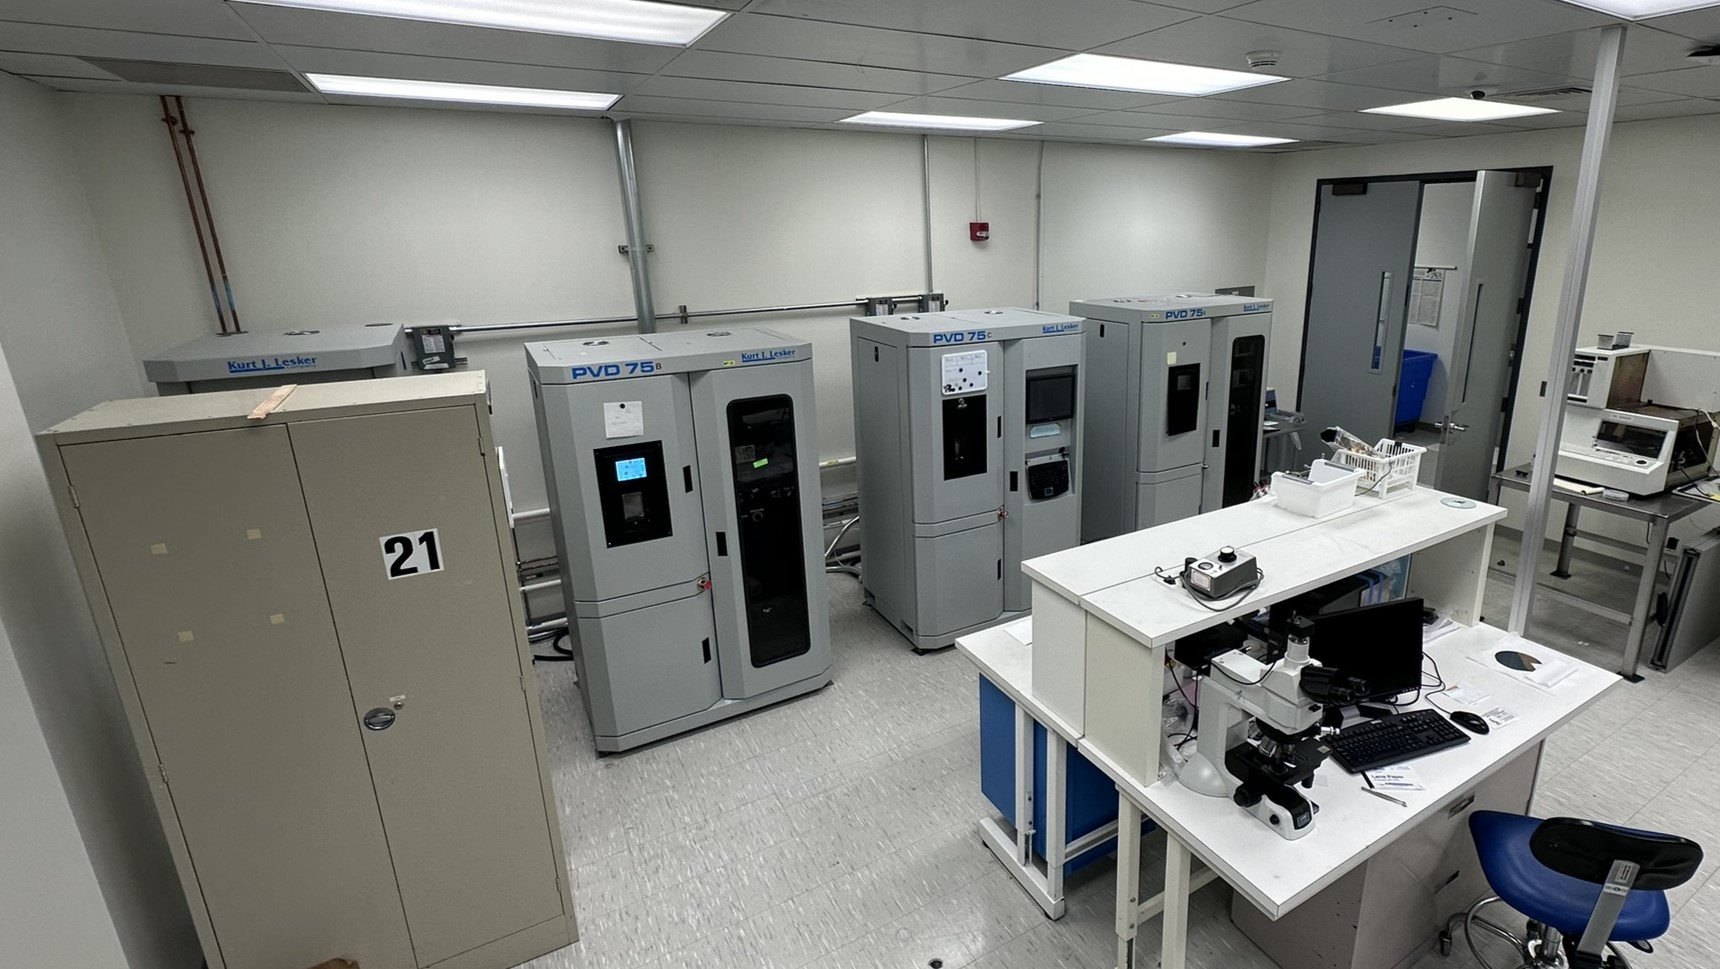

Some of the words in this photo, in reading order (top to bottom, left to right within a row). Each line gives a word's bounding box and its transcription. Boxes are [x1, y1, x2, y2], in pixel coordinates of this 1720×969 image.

[1166, 310, 1188, 320] PVD
[933, 332, 964, 344] PVD
[741, 352, 759, 361] Kurt
[769, 349, 796, 359] Lesker
[227, 360, 256, 371] Kurt
[274, 356, 317, 367] Lesker
[572, 364, 620, 379] PVD
[384, 530, 440, 578] 21
